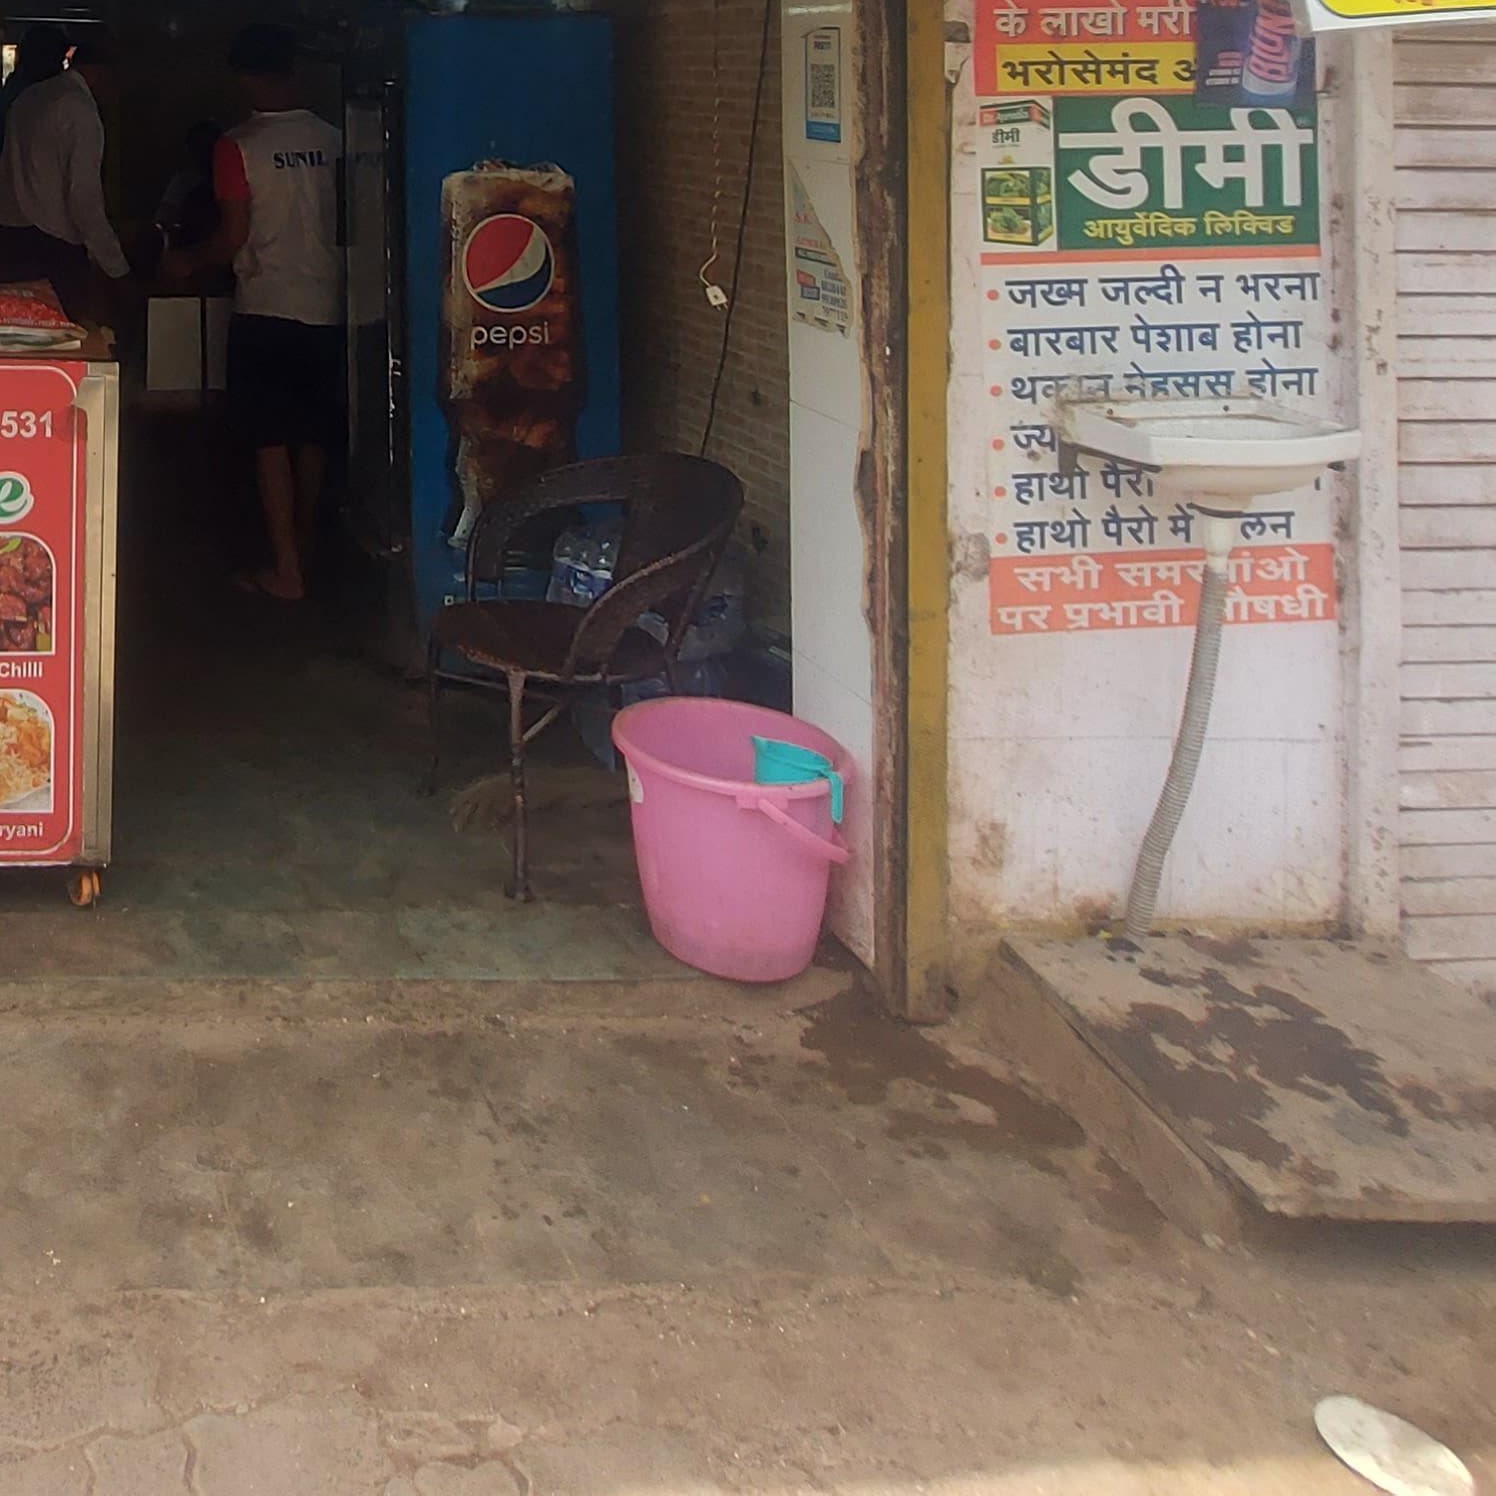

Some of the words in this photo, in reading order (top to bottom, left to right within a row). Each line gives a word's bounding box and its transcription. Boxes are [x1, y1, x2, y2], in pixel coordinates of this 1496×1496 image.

[1001, 50, 1160, 86] भरोसेमंद
[272, 150, 327, 170] SUNIL
[1058, 97, 1314, 209] डीमी
[1005, 278, 1088, 308] जख्म
[1098, 264, 1185, 305] जल्दी
[1196, 275, 1224, 303] न
[1236, 272, 1320, 302] भरना
[469, 322, 551, 348] pepsi
[1007, 326, 1120, 357] बारबार
[1130, 313, 1220, 353] पेशाब
[1230, 310, 1303, 354] होना
[1245, 357, 1318, 397] होना
[1013, 555, 1104, 592] सभी
[997, 605, 1053, 631] पर
[1063, 590, 1184, 630] प्रभावी
